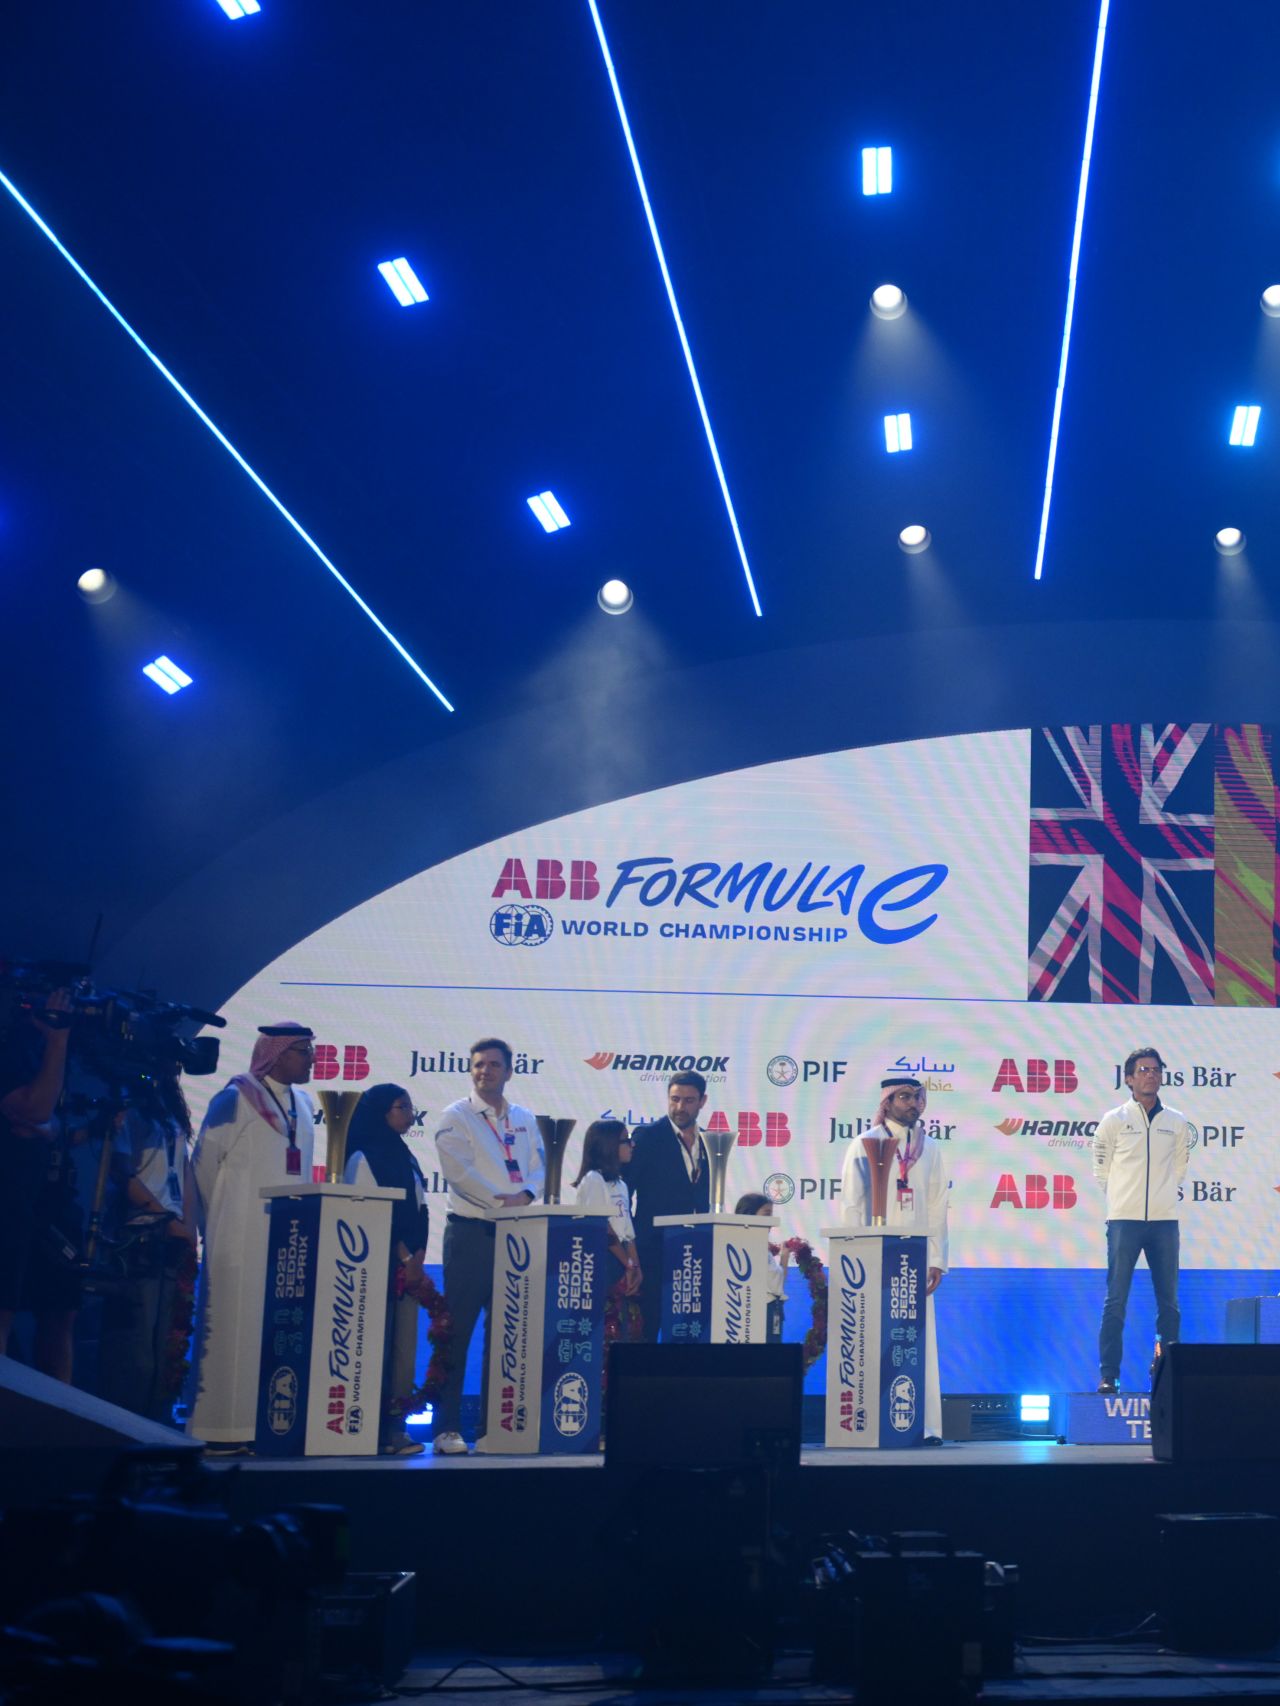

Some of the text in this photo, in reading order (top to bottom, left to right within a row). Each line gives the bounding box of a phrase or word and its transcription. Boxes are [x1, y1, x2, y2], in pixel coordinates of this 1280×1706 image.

[491, 858, 600, 900] ABB
[606, 857, 866, 916] FORMULA
[562, 919, 649, 937] WORLD
[659, 922, 848, 943] CHAMPIONSHIP
[312, 1045, 370, 1081] BB
[409, 1051, 544, 1077] Juliu är
[639, 1073, 672, 1082] drivin
[803, 1061, 848, 1083] PIF
[991, 1059, 1079, 1094] ABB
[1191, 1066, 1236, 1088] Bär
[706, 1111, 791, 1147] ABB
[829, 1117, 870, 1143] Juli
[1203, 1126, 1245, 1147] PIF
[801, 1178, 842, 1200] PIF
[990, 1174, 1078, 1209] ABB
[1192, 1181, 1236, 1202] Bär
[275, 1248, 287, 1298] 2025
[286, 1219, 299, 1298] JEDDAH
[295, 1235, 308, 1298] E-PRIX
[571, 1236, 583, 1309] JEDDAH
[582, 1252, 594, 1309] E-PRIX
[682, 1244, 692, 1314] JEDDAH
[558, 1261, 570, 1309] 2025
[672, 1269, 682, 1314] 2025
[692, 1258, 702, 1313] E-PRIX
[891, 1277, 899, 1319] 2025
[900, 1254, 908, 1319] JEDDAH
[909, 1269, 917, 1319] E-PRIX
[329, 1259, 357, 1381] FORMULA
[354, 1267, 367, 1357] CHAMPIONSHIP
[502, 1269, 523, 1382] FORMULA
[520, 1276, 530, 1358] CHAMPIONSHIP
[840, 1289, 856, 1388] FORMULA
[352, 1359, 362, 1401] WORLD
[518, 1361, 526, 1401] WORLD
[326, 1384, 346, 1434] ABB
[500, 1385, 515, 1432] ABB
[840, 1391, 853, 1432] ABB
